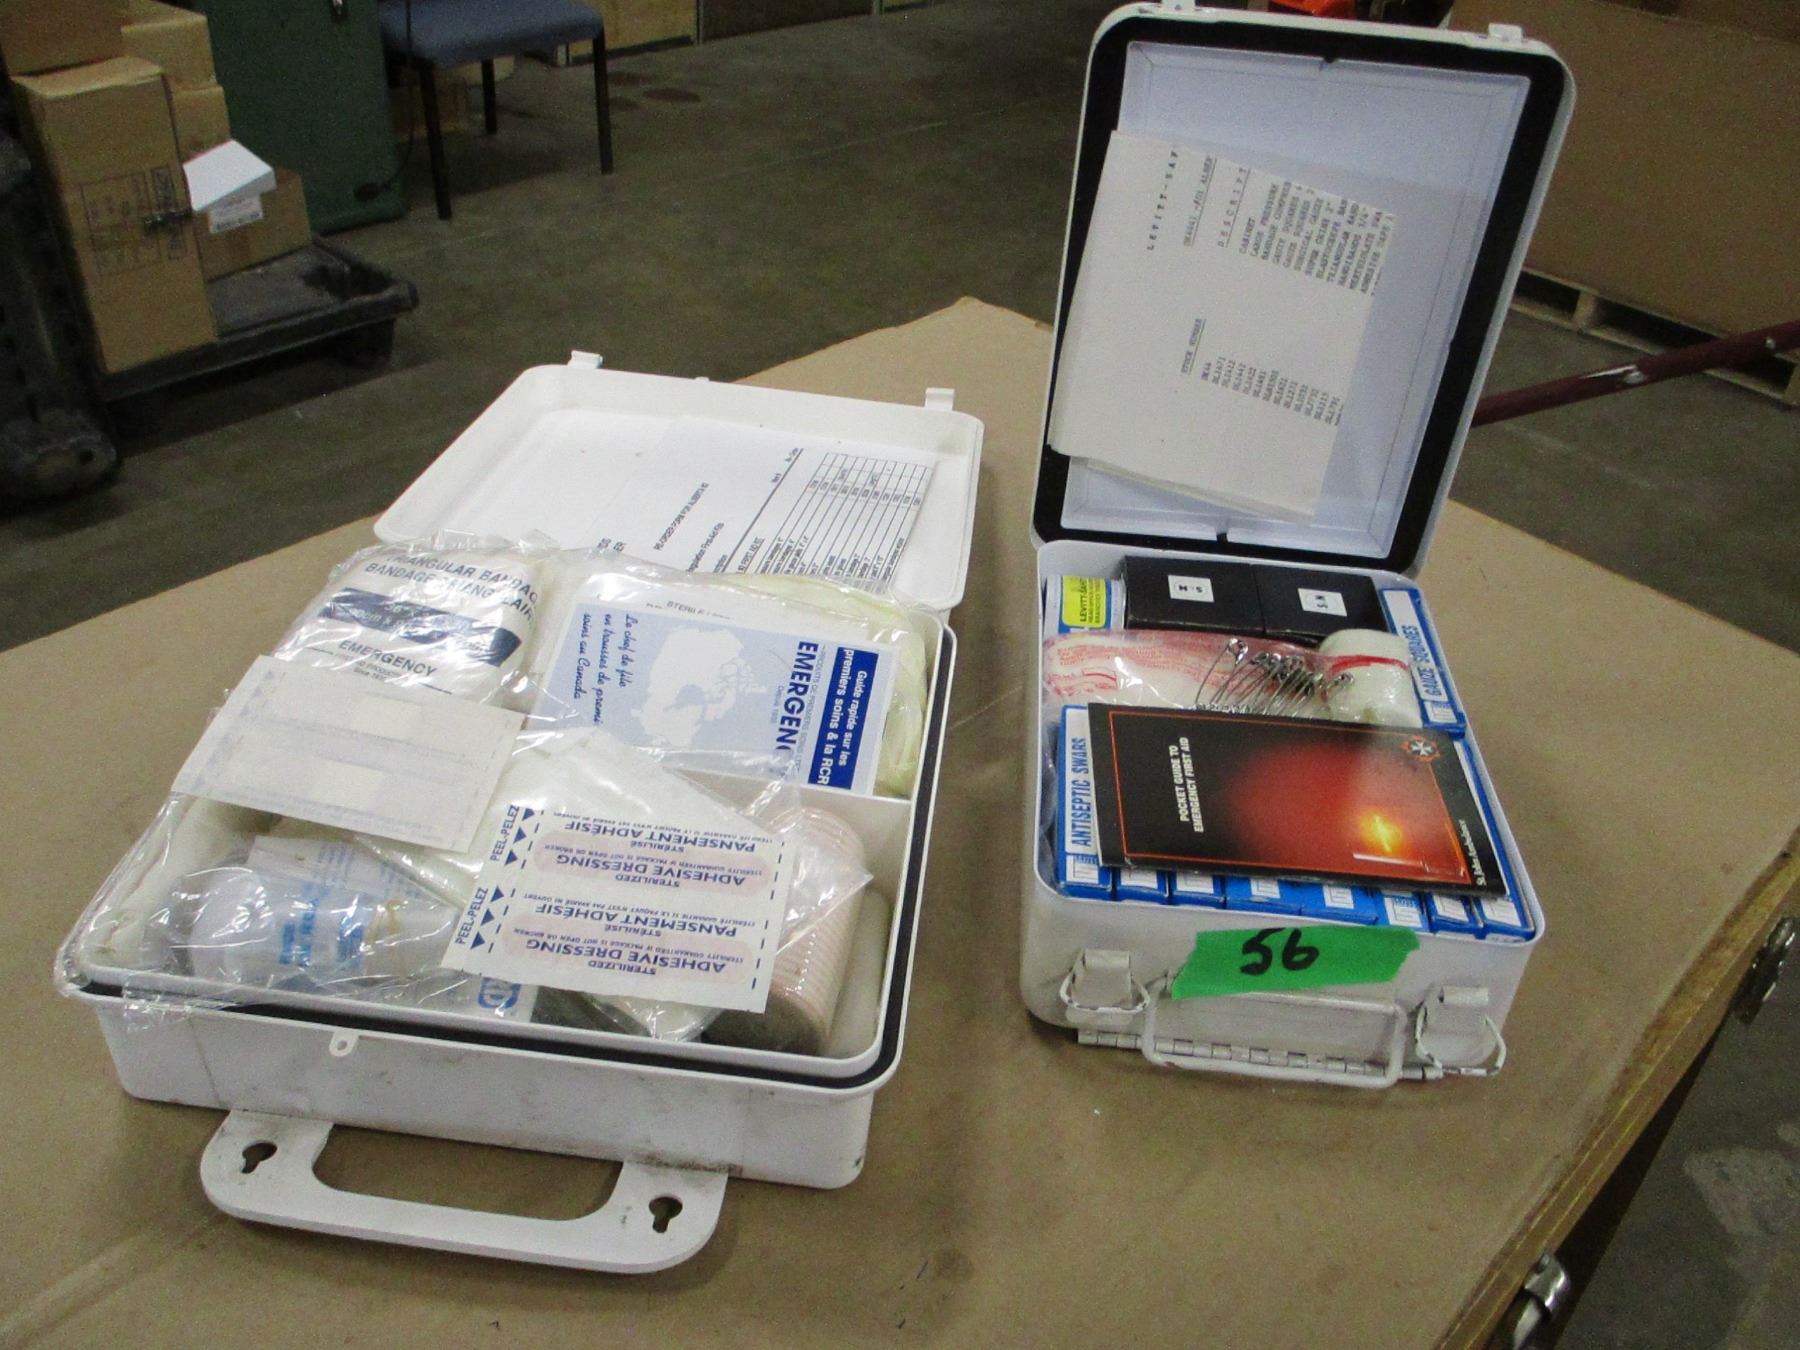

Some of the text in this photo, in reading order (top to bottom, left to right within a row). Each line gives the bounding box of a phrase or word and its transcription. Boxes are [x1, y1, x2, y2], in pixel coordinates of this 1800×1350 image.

[604, 613, 613, 626] en
[338, 639, 437, 676] EMERGENCY
[574, 613, 592, 700] soins au Canada
[599, 628, 615, 669] trousses
[616, 613, 638, 688] Le chef de file
[597, 671, 611, 685] de
[1416, 666, 1441, 695] GAUZE
[816, 648, 855, 785] premiers soins & la RCR
[837, 669, 868, 766] Guide rapide sur les
[1168, 744, 1189, 821] POCKET GUIDE TO
[1178, 737, 1204, 832] EMERGENCY FIRST AID
[1071, 778, 1091, 848] ANTISEPTIC
[489, 804, 520, 862] PEEL-PELEZ
[563, 819, 756, 853] PANSEMENT ADHÉSIF
[555, 853, 745, 886] ADHESIVE DRESSING
[614, 873, 680, 887] STERILIZED
[455, 886, 488, 945] PEEL-PELEZ
[534, 902, 737, 937] PANSEMENT ADHÉSIF
[603, 923, 662, 937] STÉRILISÉ
[524, 938, 725, 973] ADHESIVE DRESSING
[588, 959, 657, 976] STERILIZED
[1240, 927, 1319, 976] 56
